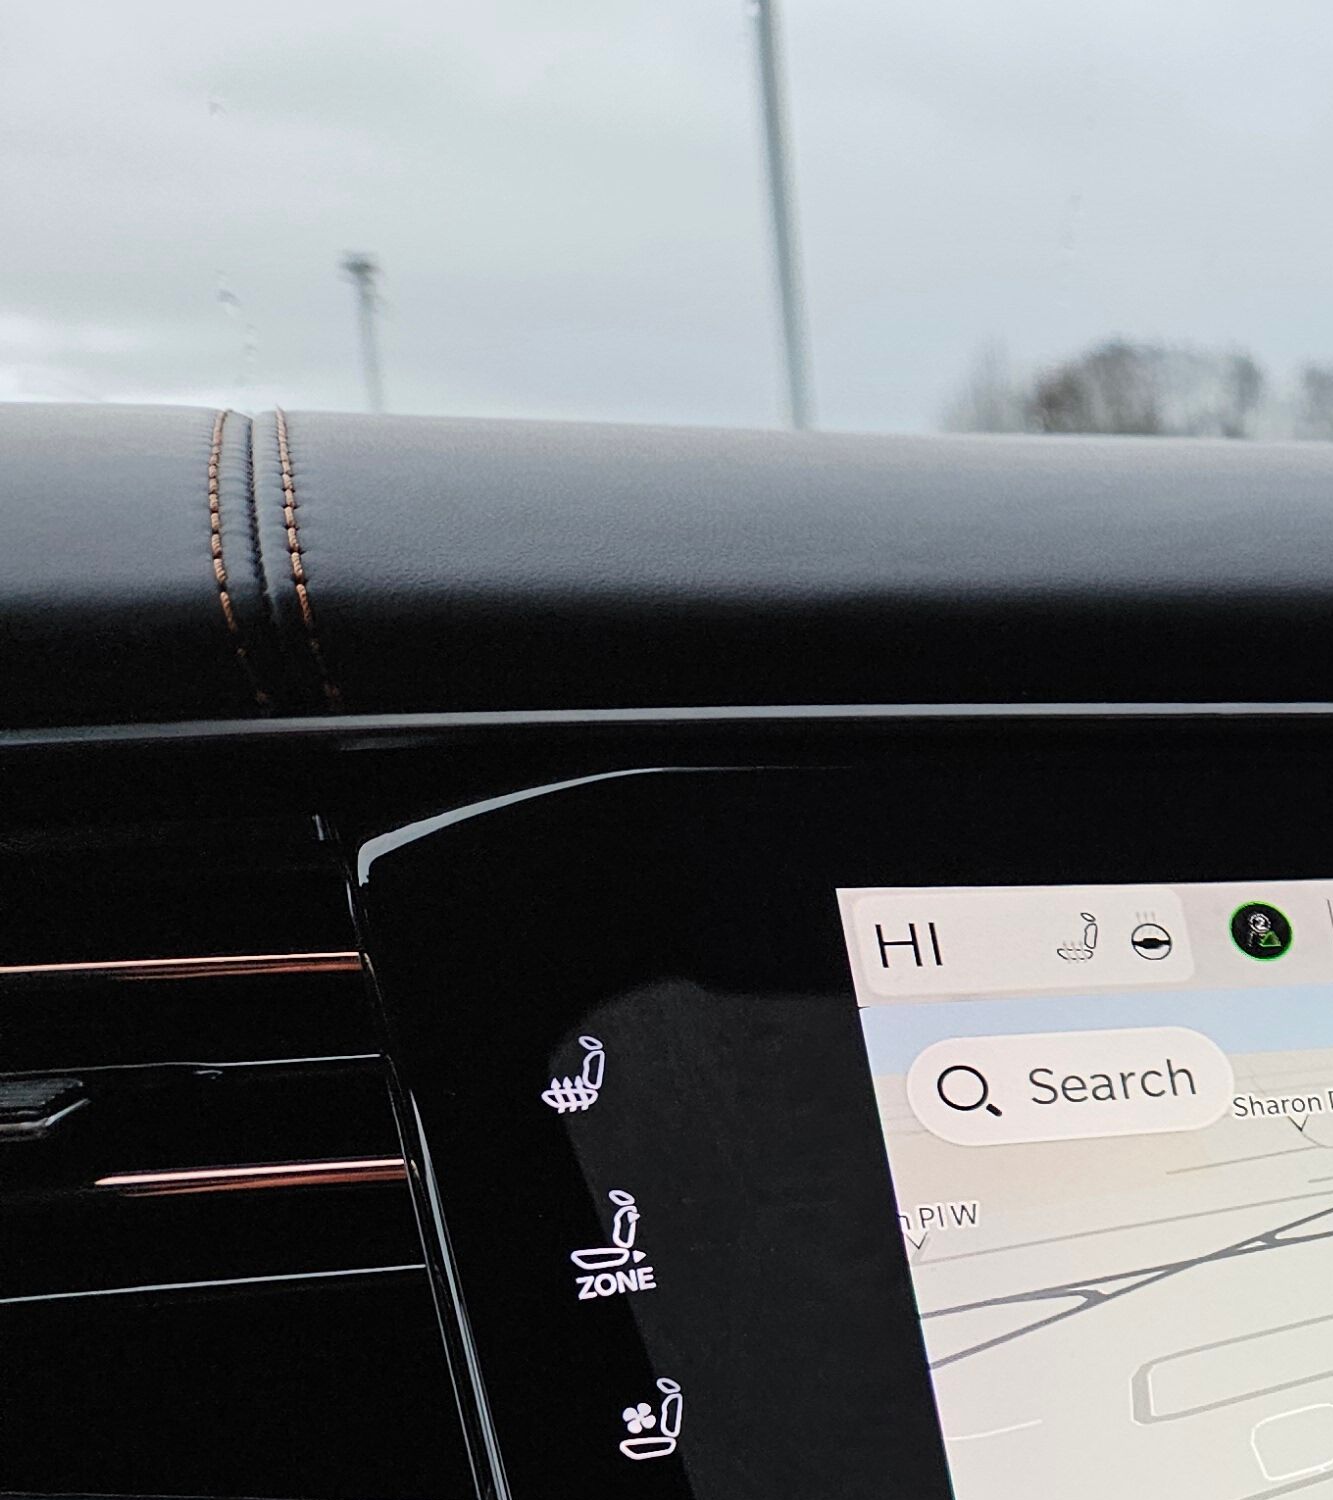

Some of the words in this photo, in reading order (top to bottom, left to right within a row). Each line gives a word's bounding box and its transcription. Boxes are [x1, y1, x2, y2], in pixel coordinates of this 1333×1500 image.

[875, 922, 943, 968] HI
[1030, 1060, 1197, 1105] Search
[1233, 1095, 1323, 1119] Sharon
[949, 1203, 978, 1226] W
[575, 1267, 656, 1300] ZONE
